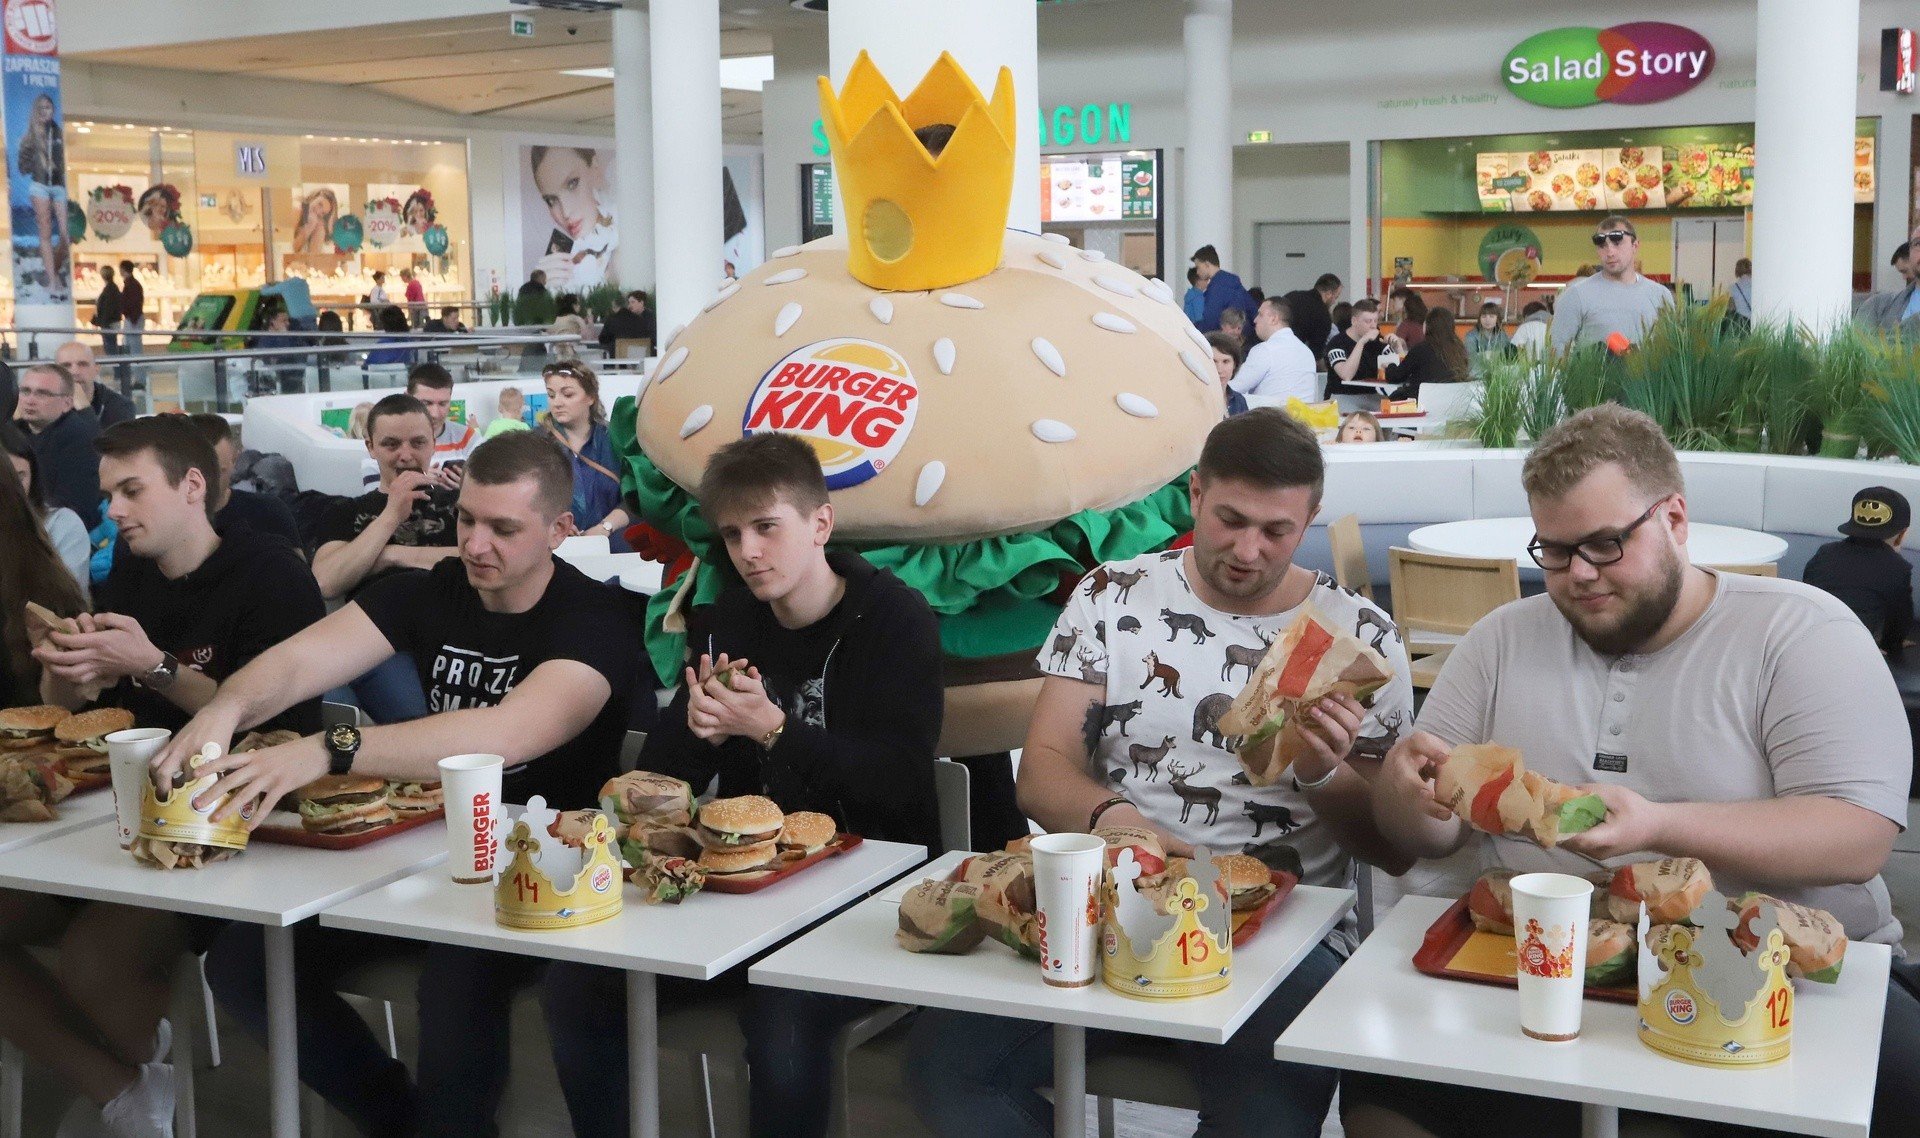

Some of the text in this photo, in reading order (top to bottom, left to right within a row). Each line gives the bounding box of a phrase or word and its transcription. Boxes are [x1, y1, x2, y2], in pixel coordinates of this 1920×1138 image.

[1508, 48, 1708, 84] Salad Story
[1378, 94, 1499, 110] naturally fresh & healthy
[368, 220, 397, 232] -20%
[768, 362, 918, 411] BURGER
[747, 390, 905, 448] KING
[473, 792, 490, 872] BURGER
[513, 872, 538, 904] 14
[1177, 929, 1209, 966] 13
[1670, 1004, 1693, 1014] KING
[1766, 987, 1790, 1029] 12
